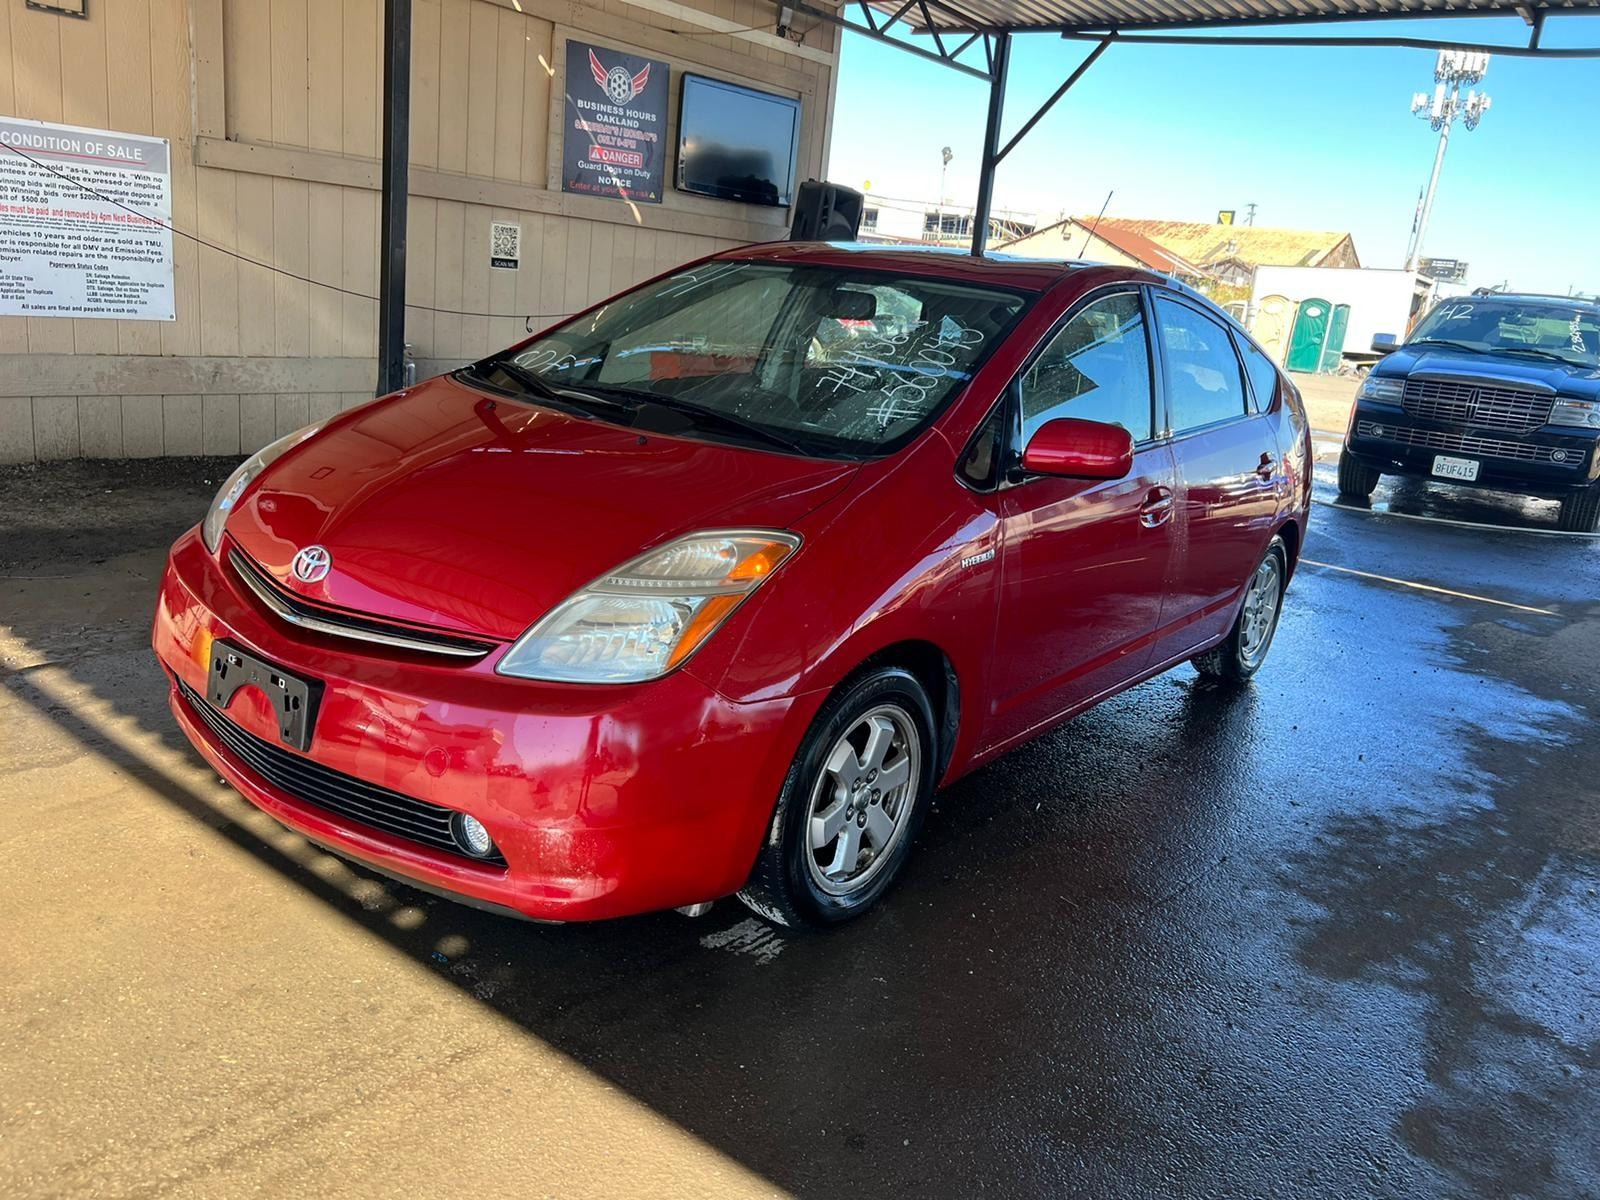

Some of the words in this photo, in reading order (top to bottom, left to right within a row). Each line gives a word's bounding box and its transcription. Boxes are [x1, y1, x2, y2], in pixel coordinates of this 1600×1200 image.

[577, 99, 624, 115] BUSINESS
[626, 110, 657, 122] HOURS
[596, 114, 640, 128] OAKLAND
[0, 131, 82, 153] CONDITION
[85, 142, 103, 155] OF
[107, 145, 143, 160] SALE
[602, 150, 640, 165] DANGER
[46, 164, 63, 172] sold
[93, 169, 117, 178] where
[577, 160, 602, 171] Guard
[603, 164, 622, 174] Dogs
[634, 168, 651, 179] Duty
[82, 177, 122, 187] expressed
[569, 180, 591, 191] Enter
[592, 183, 600, 192] at
[598, 175, 632, 187] NOTICE
[27, 179, 43, 187] bids
[58, 183, 83, 192] require
[95, 188, 129, 197] immediate
[131, 191, 155, 200] deposit
[10, 187, 40, 197] Winning
[44, 189, 59, 197] bids
[127, 198, 151, 208] require
[21, 195, 48, 204] $500.00
[10, 205, 26, 214] must
[27, 206, 34, 215] be
[36, 207, 49, 217] paid
[52, 208, 63, 217] and
[64, 210, 91, 219] removed
[91, 211, 98, 221] by
[99, 212, 111, 223] 4pm
[113, 213, 126, 223] Next
[127, 214, 152, 225] Business
[44, 233, 65, 241] years
[83, 235, 102, 243] older
[18, 240, 59, 249] responsible
[115, 246, 146, 255] Emission
[33, 248, 57, 256] related
[59, 251, 83, 259] repairs
[111, 254, 155, 264] responsibility
[49, 260, 76, 269] Paperwork
[77, 262, 93, 271] Status
[94, 263, 109, 271] Codes
[1440, 304, 1474, 320] 42
[1435, 463, 1475, 478] 8FUF415
